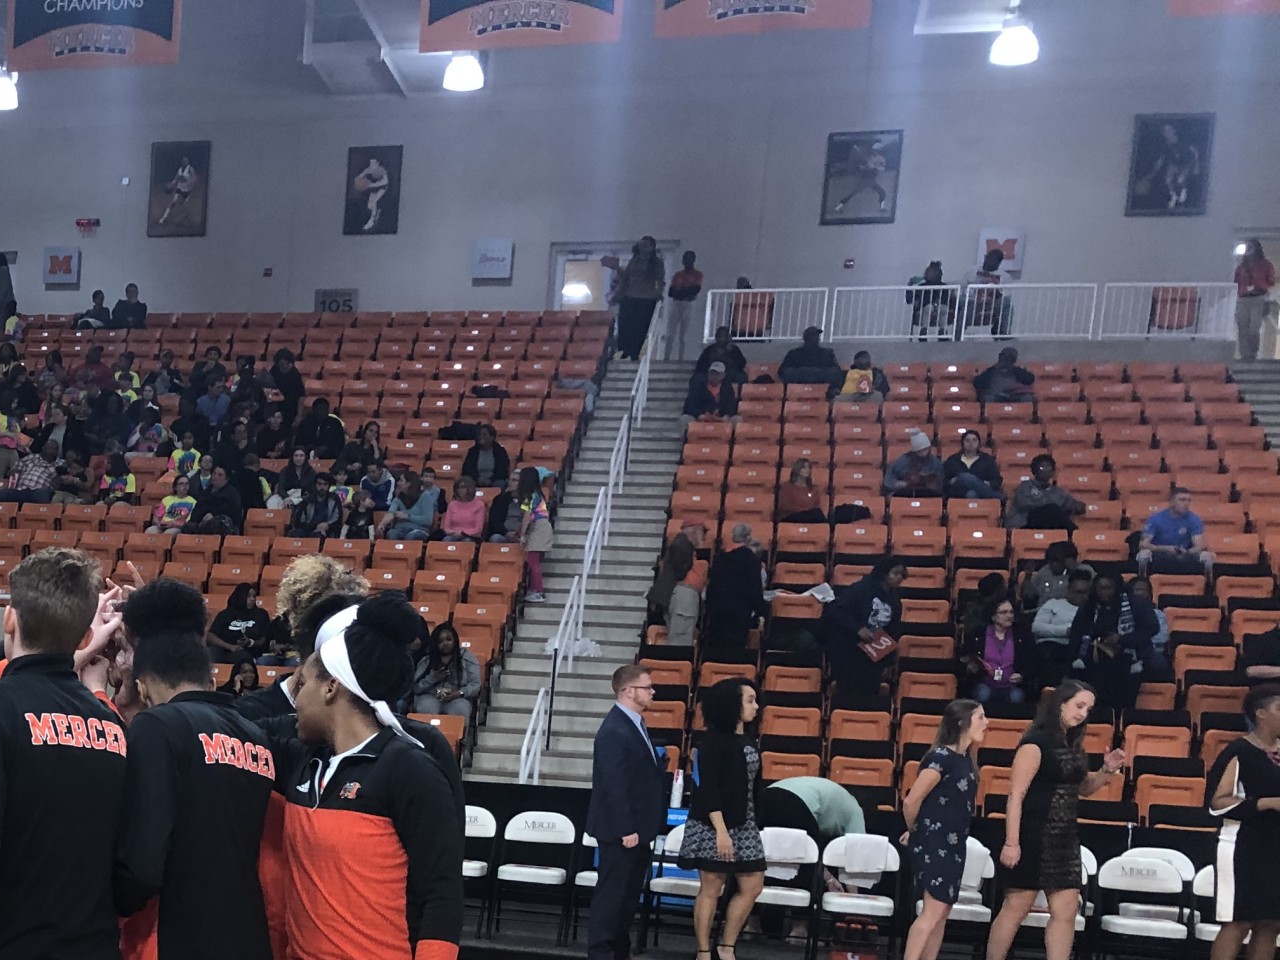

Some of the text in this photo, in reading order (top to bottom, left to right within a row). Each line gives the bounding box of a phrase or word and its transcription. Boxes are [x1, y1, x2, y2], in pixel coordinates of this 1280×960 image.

[44, 0, 144, 13] CHAMPIONS
[49, 255, 72, 274] M
[320, 299, 353, 313] 105
